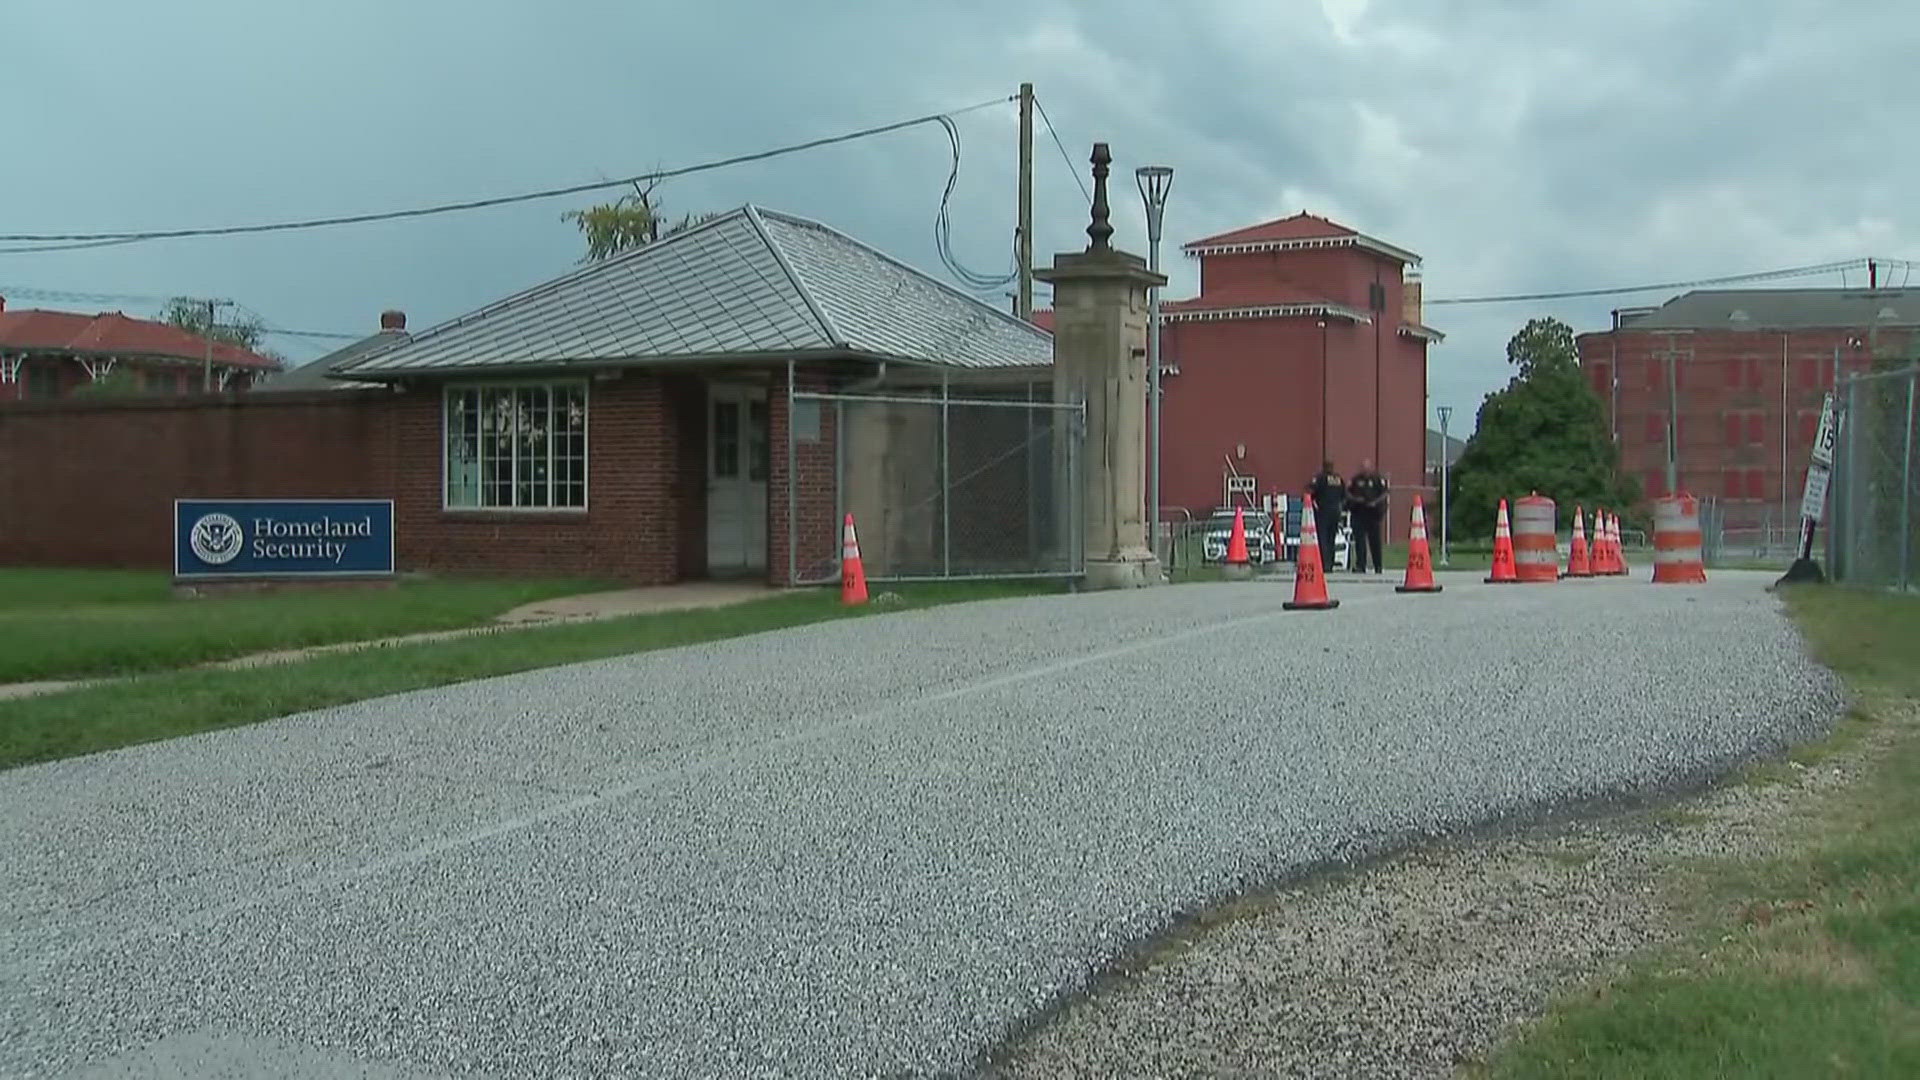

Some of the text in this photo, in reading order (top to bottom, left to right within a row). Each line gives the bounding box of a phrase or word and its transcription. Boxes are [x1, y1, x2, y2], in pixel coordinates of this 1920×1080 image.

[1819, 427, 1834, 451] 15
[253, 516, 372, 537] Homeland
[252, 539, 347, 564] Security
